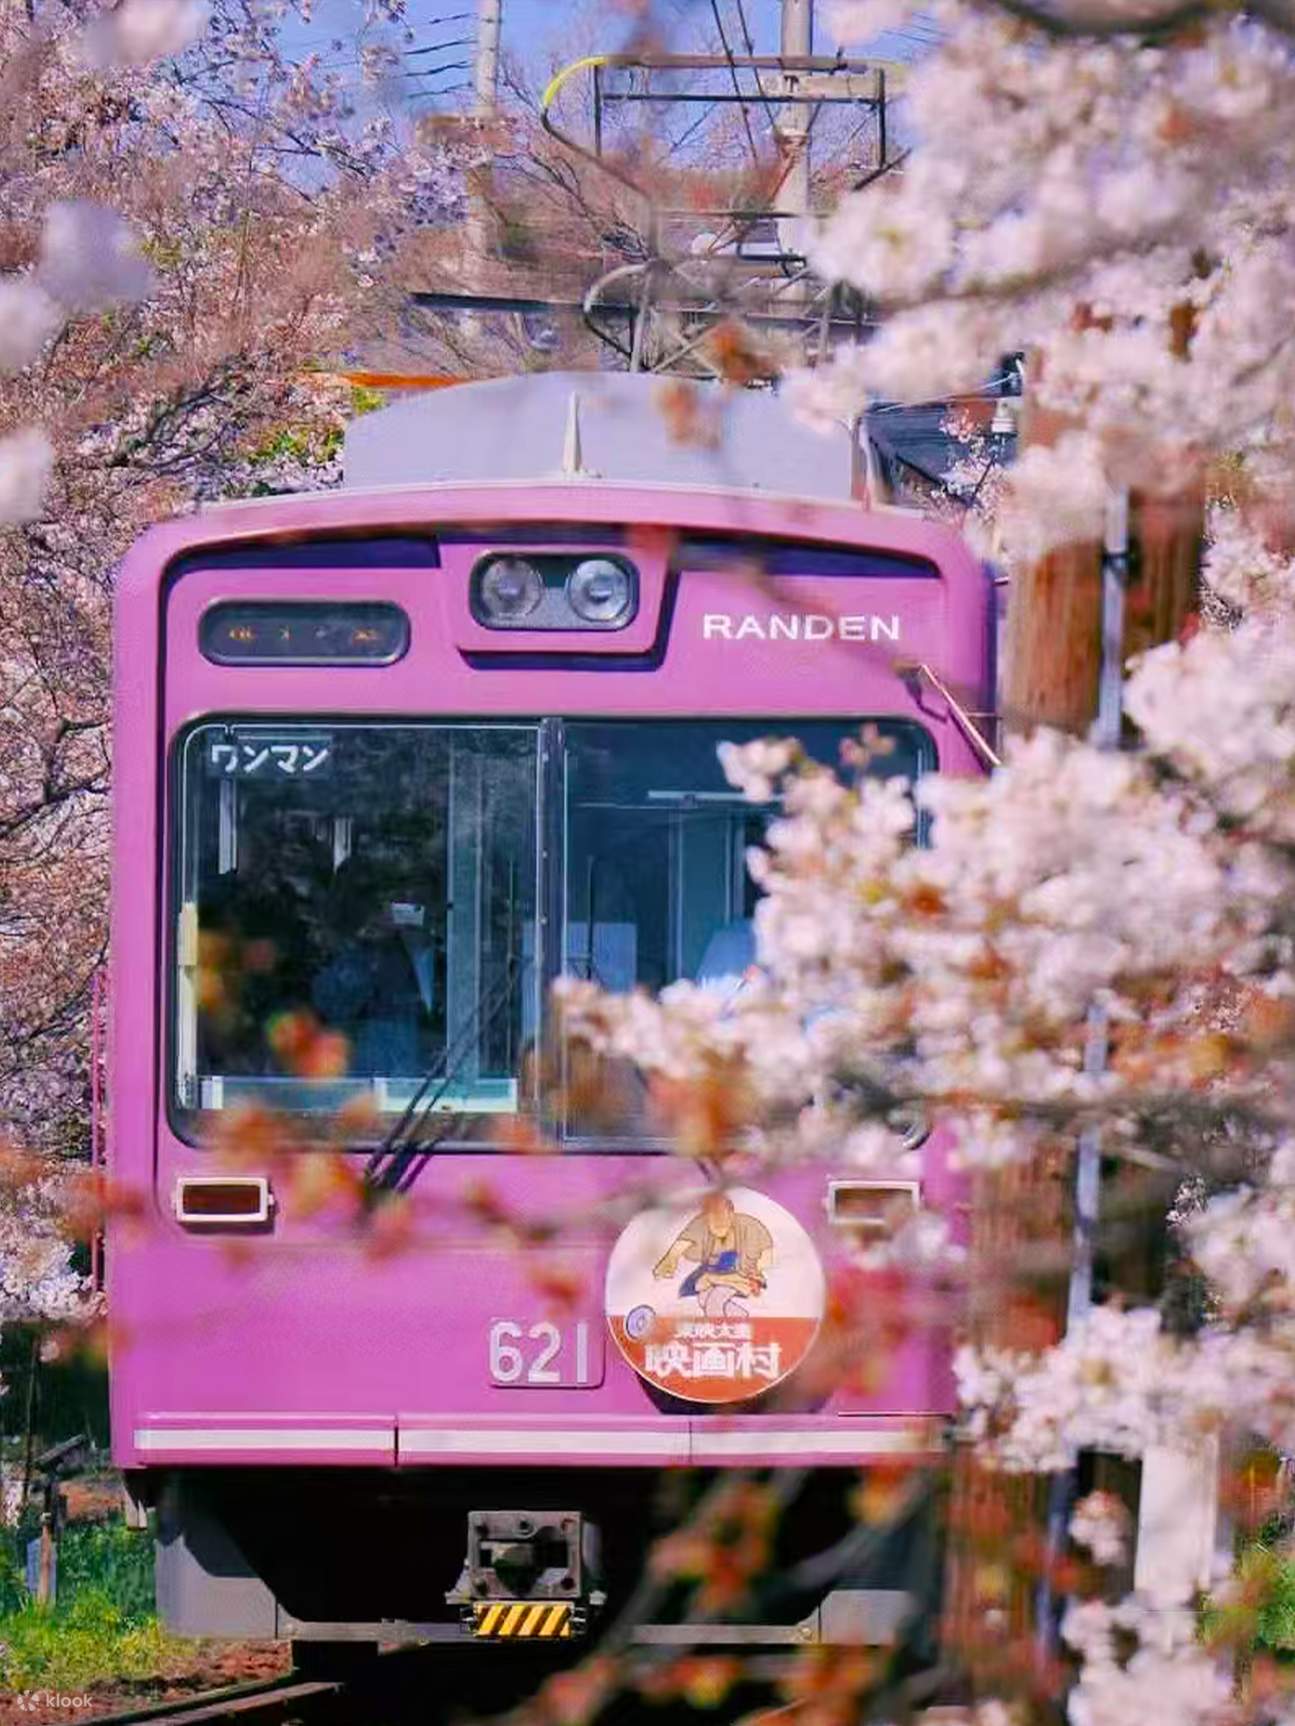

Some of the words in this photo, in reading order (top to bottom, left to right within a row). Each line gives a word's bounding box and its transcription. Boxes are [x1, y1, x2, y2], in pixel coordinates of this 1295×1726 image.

[703, 614, 900, 640] RANDEN
[211, 744, 330, 773] ワンマン
[490, 1321, 588, 1383] 621
[644, 1341, 782, 1378] 映画村
